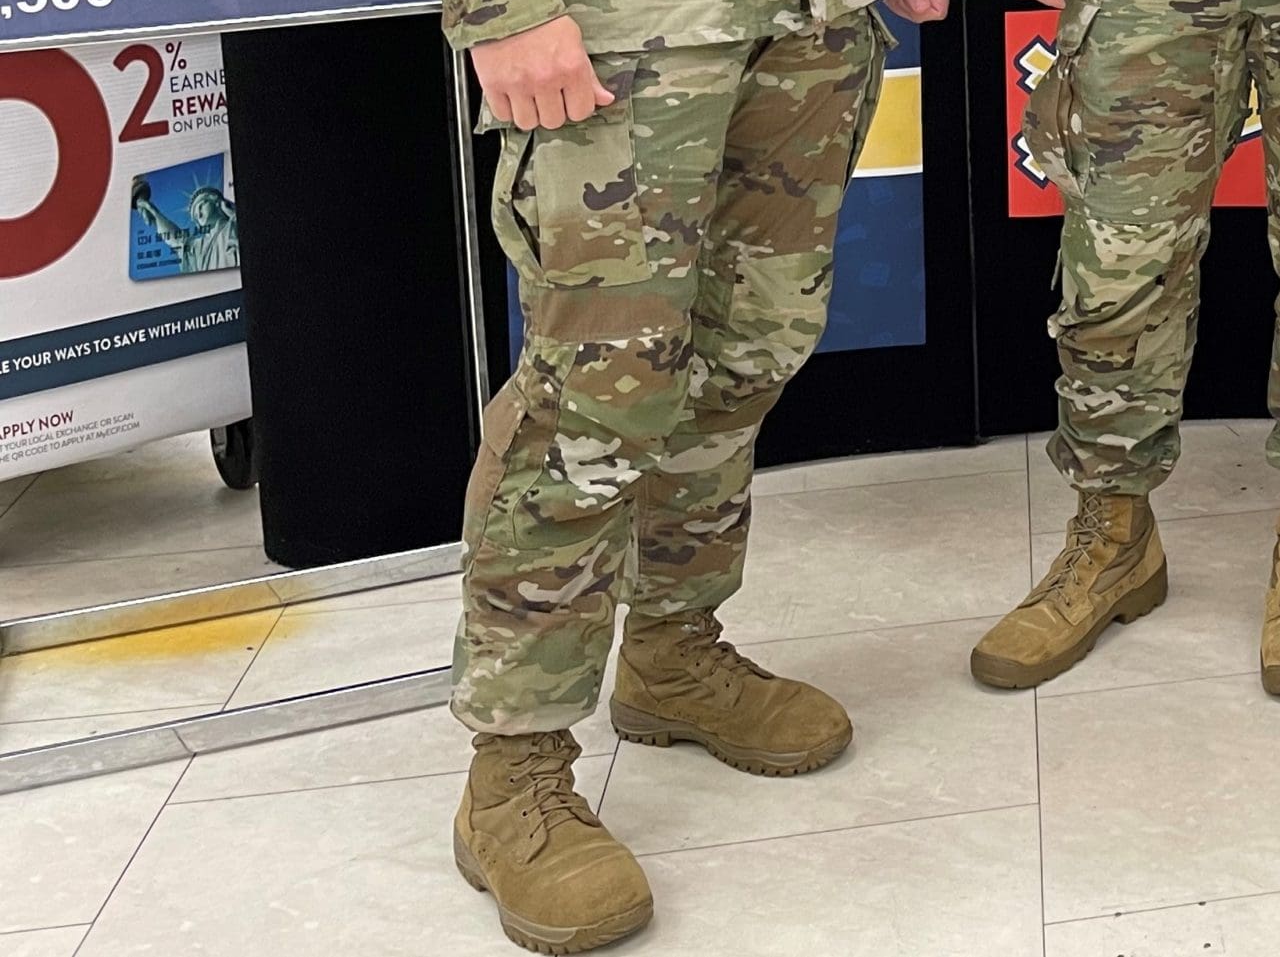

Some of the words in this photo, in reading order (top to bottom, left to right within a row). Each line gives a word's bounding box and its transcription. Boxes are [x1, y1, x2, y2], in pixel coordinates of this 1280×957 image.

[173, 119, 194, 133] ON
[12, 351, 52, 371] YOUR
[55, 342, 91, 362] WAYS
[93, 337, 111, 354] TO
[114, 328, 147, 349] SAVE
[149, 320, 182, 340] WITH
[184, 306, 241, 332] MILITARY
[0, 419, 35, 441] PPLY
[38, 409, 74, 432] NOW
[28, 433, 54, 446] LOCAL
[56, 420, 98, 439] EXCHANGE
